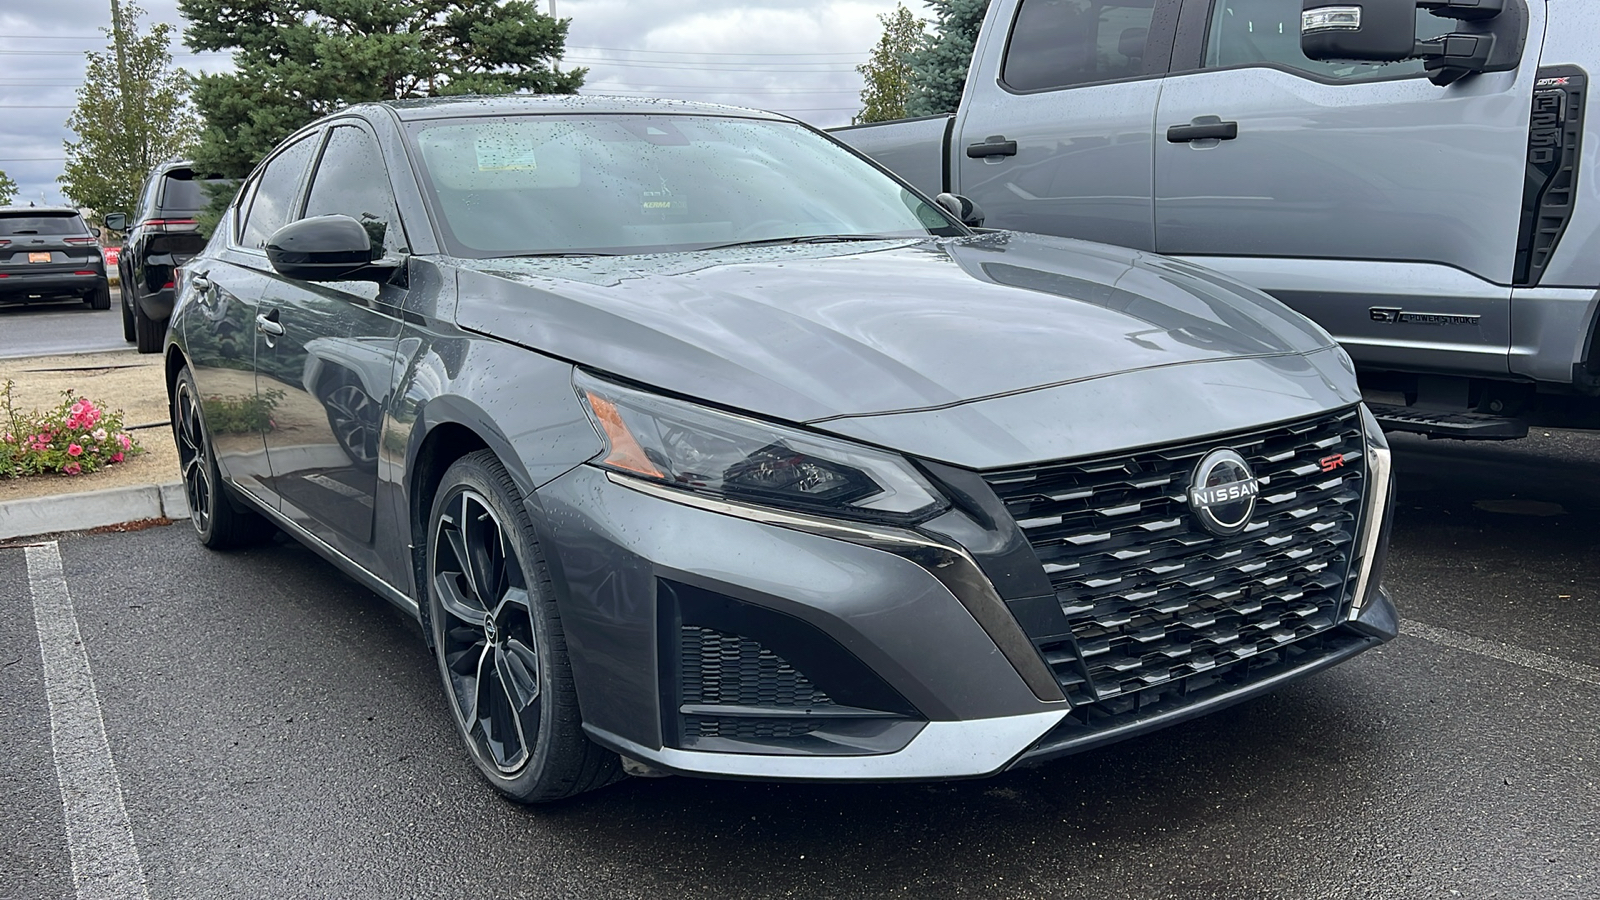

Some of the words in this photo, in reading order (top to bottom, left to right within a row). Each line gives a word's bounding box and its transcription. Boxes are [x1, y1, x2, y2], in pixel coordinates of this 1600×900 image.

[643, 201, 671, 209] KERMA
[1319, 453, 1344, 473] SR
[1193, 480, 1259, 505] NISSAN
